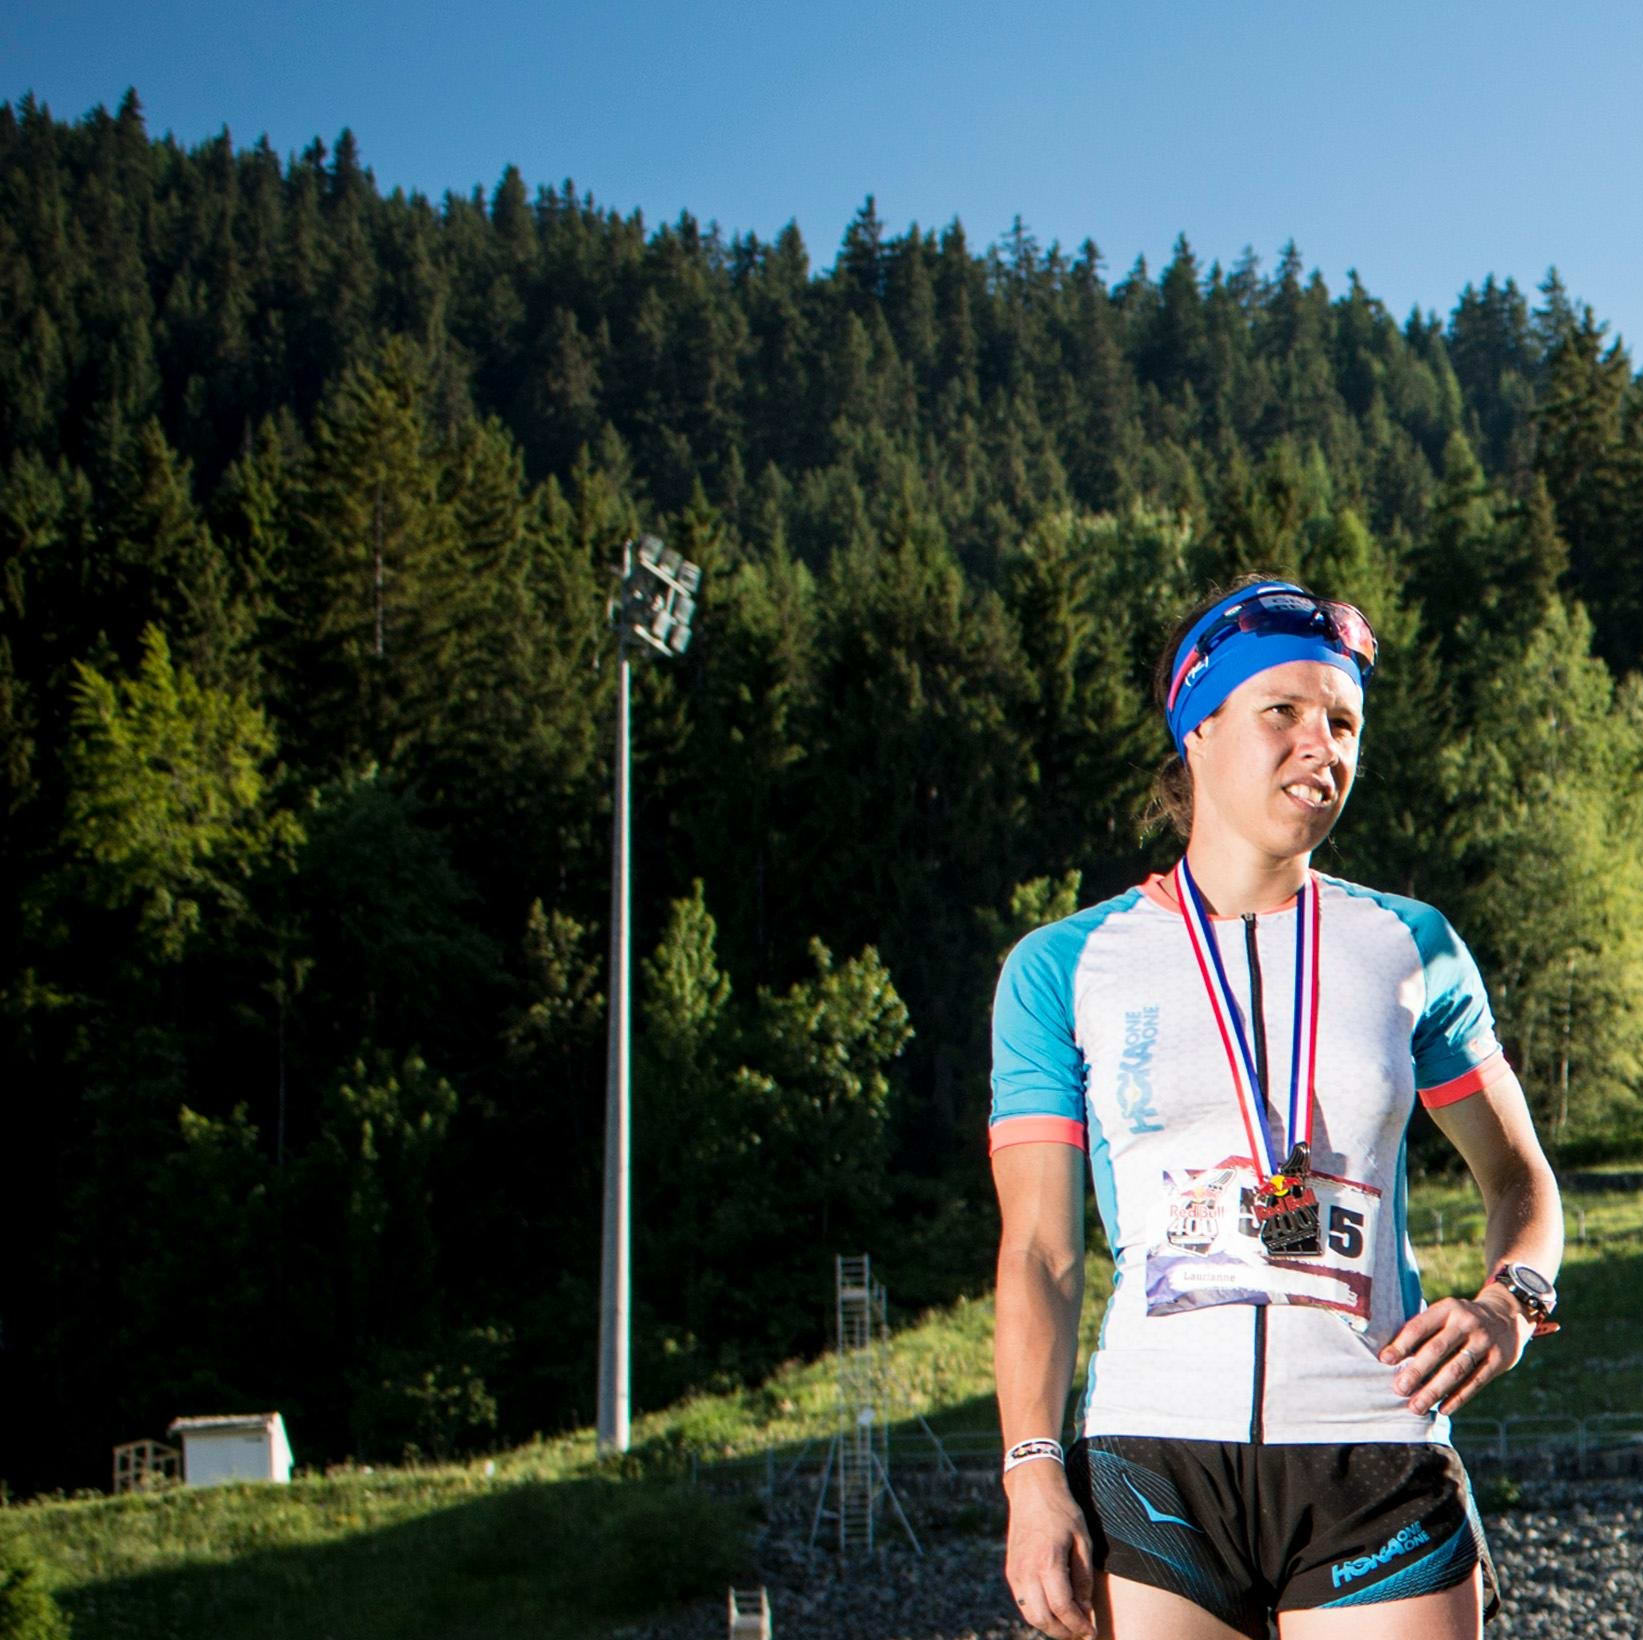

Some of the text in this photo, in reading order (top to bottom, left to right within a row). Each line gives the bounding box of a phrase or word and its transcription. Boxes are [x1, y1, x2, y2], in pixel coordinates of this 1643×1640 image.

[1125, 1011, 1141, 1046] ONE
[1142, 1004, 1160, 1039] ONE
[1170, 1217, 1217, 1236] 400
[1183, 1271, 1236, 1283] Laurianne
[1331, 1520, 1422, 1589] HOKA ONE
[1404, 1530, 1431, 1551] ONE
